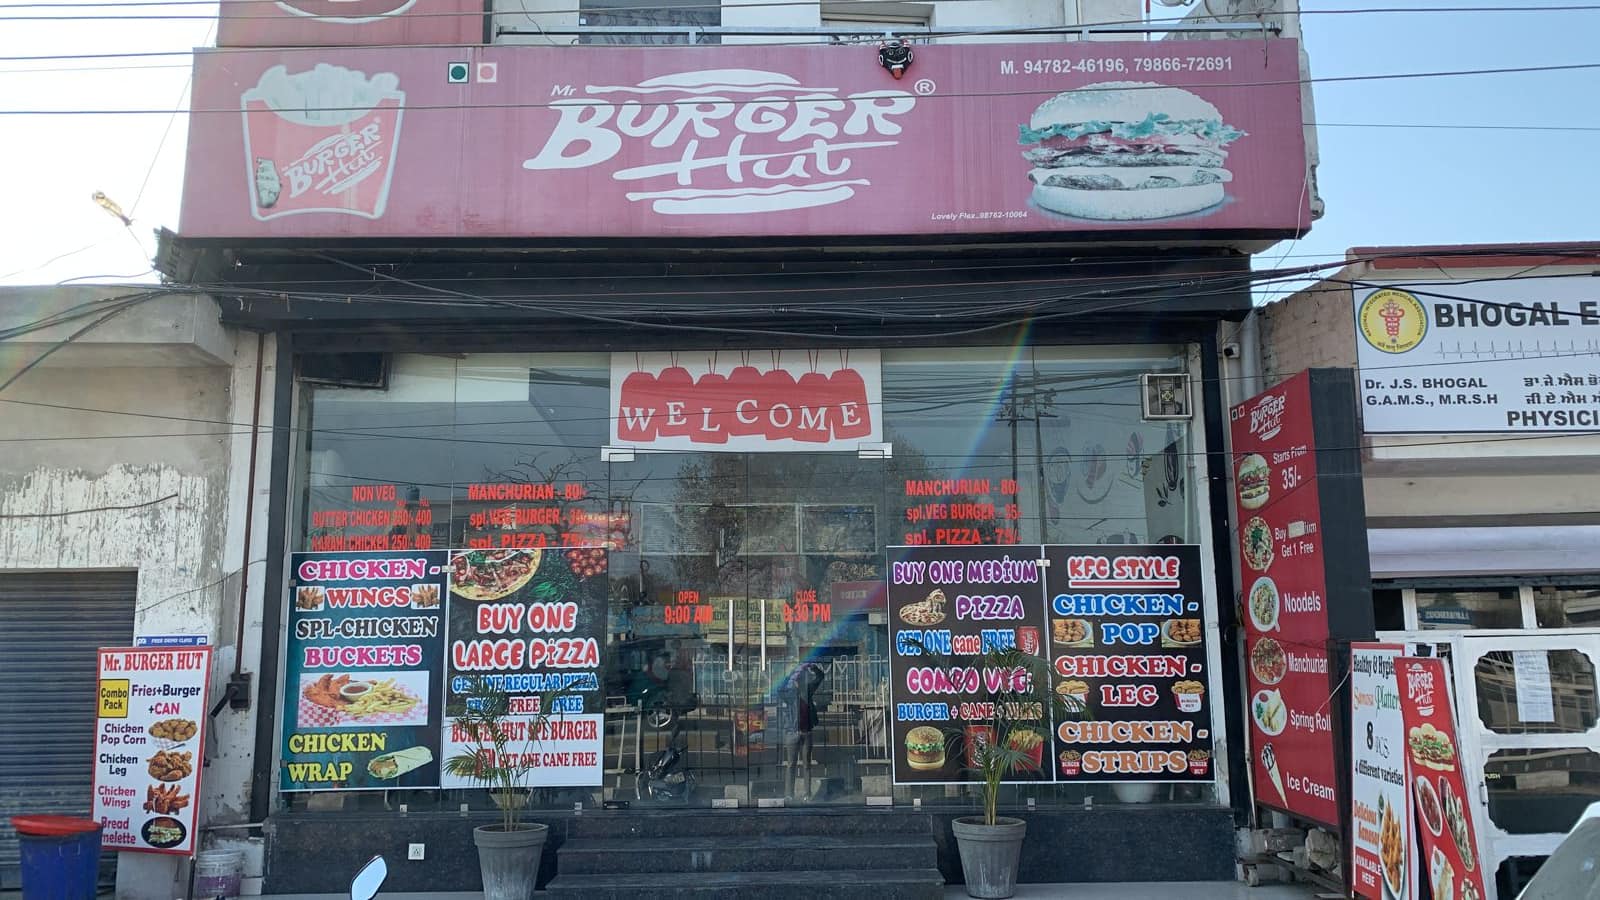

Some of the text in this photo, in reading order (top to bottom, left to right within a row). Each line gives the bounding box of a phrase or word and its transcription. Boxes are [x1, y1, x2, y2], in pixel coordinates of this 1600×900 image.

[1000, 56, 1232, 74] M. 94782-46196, 79866-72691
[551, 84, 577, 97] Mr
[522, 90, 916, 170] BURGER
[284, 122, 380, 198] BURGER
[315, 141, 382, 190] Hut
[612, 134, 899, 185] Hut
[931, 212, 957, 220] Lovely
[1434, 301, 1569, 328] BHOGAL
[1365, 377, 1487, 390] Dr. J.S. BHOGAL
[1366, 393, 1498, 407] G.A.M.S., M.R.S.H
[621, 399, 862, 432] WELCOME
[1249, 394, 1285, 434] BURGER
[1507, 410, 1599, 427] PHYSICI
[906, 479, 990, 496] MANCHURIAN
[1281, 466, 1302, 490] 35/-
[352, 484, 396, 502] NON VEG
[468, 483, 554, 500] MANCHURIAN
[312, 510, 348, 527] BUTTER
[350, 509, 390, 527] CHICKEN
[515, 507, 560, 525] BURGER
[951, 503, 995, 520] BURGER
[349, 534, 389, 551] CHICKEN
[501, 533, 547, 548] PIZZA
[936, 528, 982, 544] PIZZA
[1274, 527, 1287, 542] Buy
[1299, 541, 1314, 554] Free
[299, 558, 426, 581] CHICKEN
[892, 561, 925, 584] BUY
[929, 560, 964, 584] ONE
[1067, 555, 1180, 580] KFC STYLE
[327, 586, 411, 608] WINGS
[678, 590, 699, 604] OPEN
[795, 589, 816, 604] CLOSE
[1053, 594, 1185, 616] CHICKEN
[1284, 591, 1321, 613] Noodels
[477, 601, 578, 633] BUY ONE
[664, 604, 690, 624] 9:00
[812, 603, 831, 622] PM
[955, 594, 1025, 620] PIZZA
[295, 616, 439, 640] SPL-CHICKEN
[1101, 622, 1159, 645] POP
[896, 630, 923, 656] GET
[923, 629, 951, 656] ONE
[952, 635, 981, 654] cane
[981, 629, 1016, 656] FREE
[104, 652, 203, 671] Mr. BURGER HUT
[303, 644, 422, 668] BUCKETS
[452, 639, 525, 670] LARGE
[1288, 652, 1328, 674] Manchurian
[1055, 655, 1187, 677] CHICKEN
[100, 687, 128, 699] Combo
[452, 676, 473, 694] GE
[504, 674, 560, 692] REGULAR
[1406, 671, 1434, 699] BURGER
[104, 699, 123, 710] Pack
[508, 696, 541, 714] FREE
[552, 695, 583, 714] FREE
[1100, 684, 1159, 707] LEG
[897, 702, 950, 721] BURGER
[960, 702, 995, 720] CANE
[1290, 709, 1332, 733] Spring Roll
[104, 723, 144, 733] Chicken
[550, 719, 598, 742] BURGER
[1058, 720, 1193, 743] CHICKEN
[1367, 721, 1373, 750] 8
[101, 734, 146, 746] Pop Corn
[288, 732, 386, 754] CHICKEN
[99, 753, 138, 764] Chicken
[521, 752, 541, 768] ONE
[543, 752, 570, 767] CANE
[571, 751, 597, 767] FREE
[1082, 750, 1188, 773] STRIPS
[109, 765, 127, 776] Leg
[287, 761, 353, 782] WRAP
[97, 785, 136, 797] Chicken
[1286, 771, 1335, 801] Ice Cream
[102, 797, 131, 809] Wings
[101, 816, 129, 829] Bread
